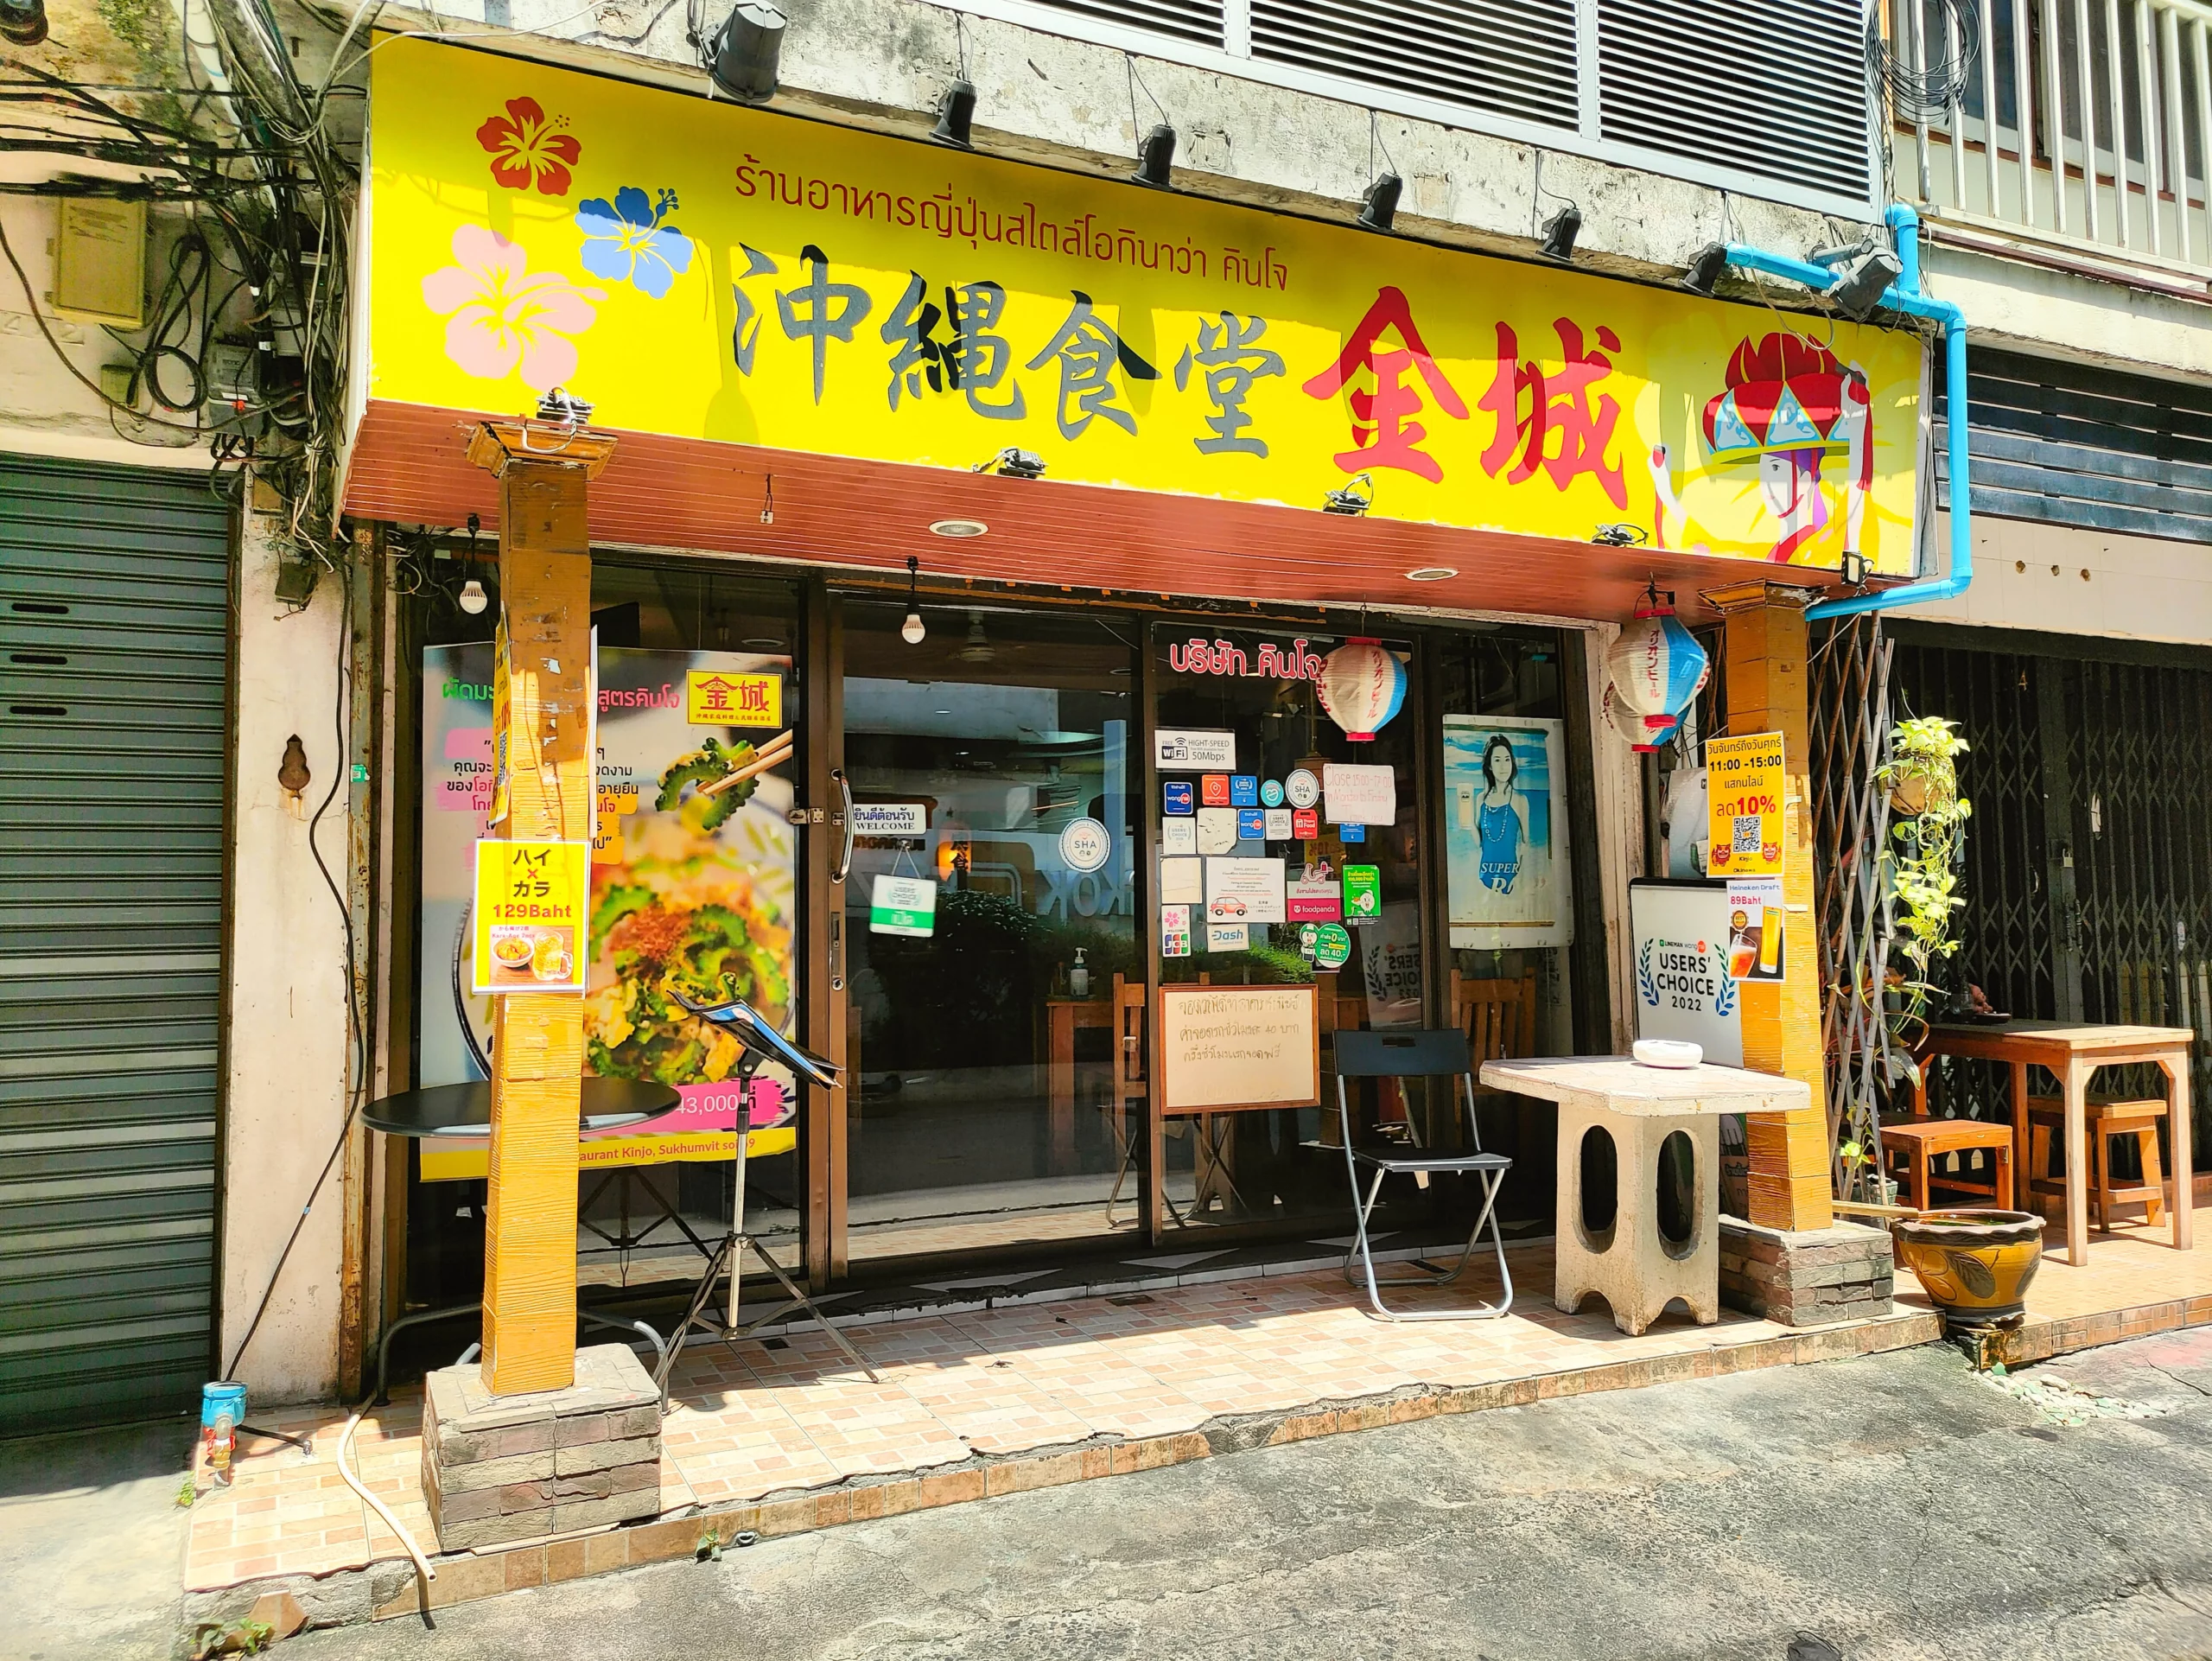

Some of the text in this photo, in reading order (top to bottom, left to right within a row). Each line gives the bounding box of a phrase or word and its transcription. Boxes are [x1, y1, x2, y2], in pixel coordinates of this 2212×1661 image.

[1223, 246, 1287, 290] คินโจ
[733, 243, 1627, 512] 沖縄食堂 金城
[1171, 639, 1247, 676] บริษัท
[1647, 629, 1661, 698] オリオンビール
[695, 676, 769, 712] 金城
[1707, 736, 1782, 754] วันจันทร์ถึงวันศุกร์
[1192, 751, 1225, 762] 50Mbps
[1710, 758, 1740, 772] 11:00
[1725, 775, 1764, 788] แสกนไลน์
[854, 807, 915, 821] ยินดีต้อนรับ
[1074, 840, 1096, 849] SHA
[513, 849, 551, 866] ハイ
[1480, 862, 1520, 875] SUPER
[513, 880, 550, 897] カラ
[1731, 896, 1762, 905] 89Baht
[493, 904, 572, 918] 129Baht
[1302, 905, 1335, 914] foodpanda
[1211, 929, 1243, 940] Dash
[1659, 952, 1710, 973] USERS'
[1656, 973, 1714, 996] CHOICE
[1671, 996, 1701, 1011] 2022
[622, 1146, 656, 1160] Kinjo,
[658, 1138, 720, 1155] Sukhumvit
